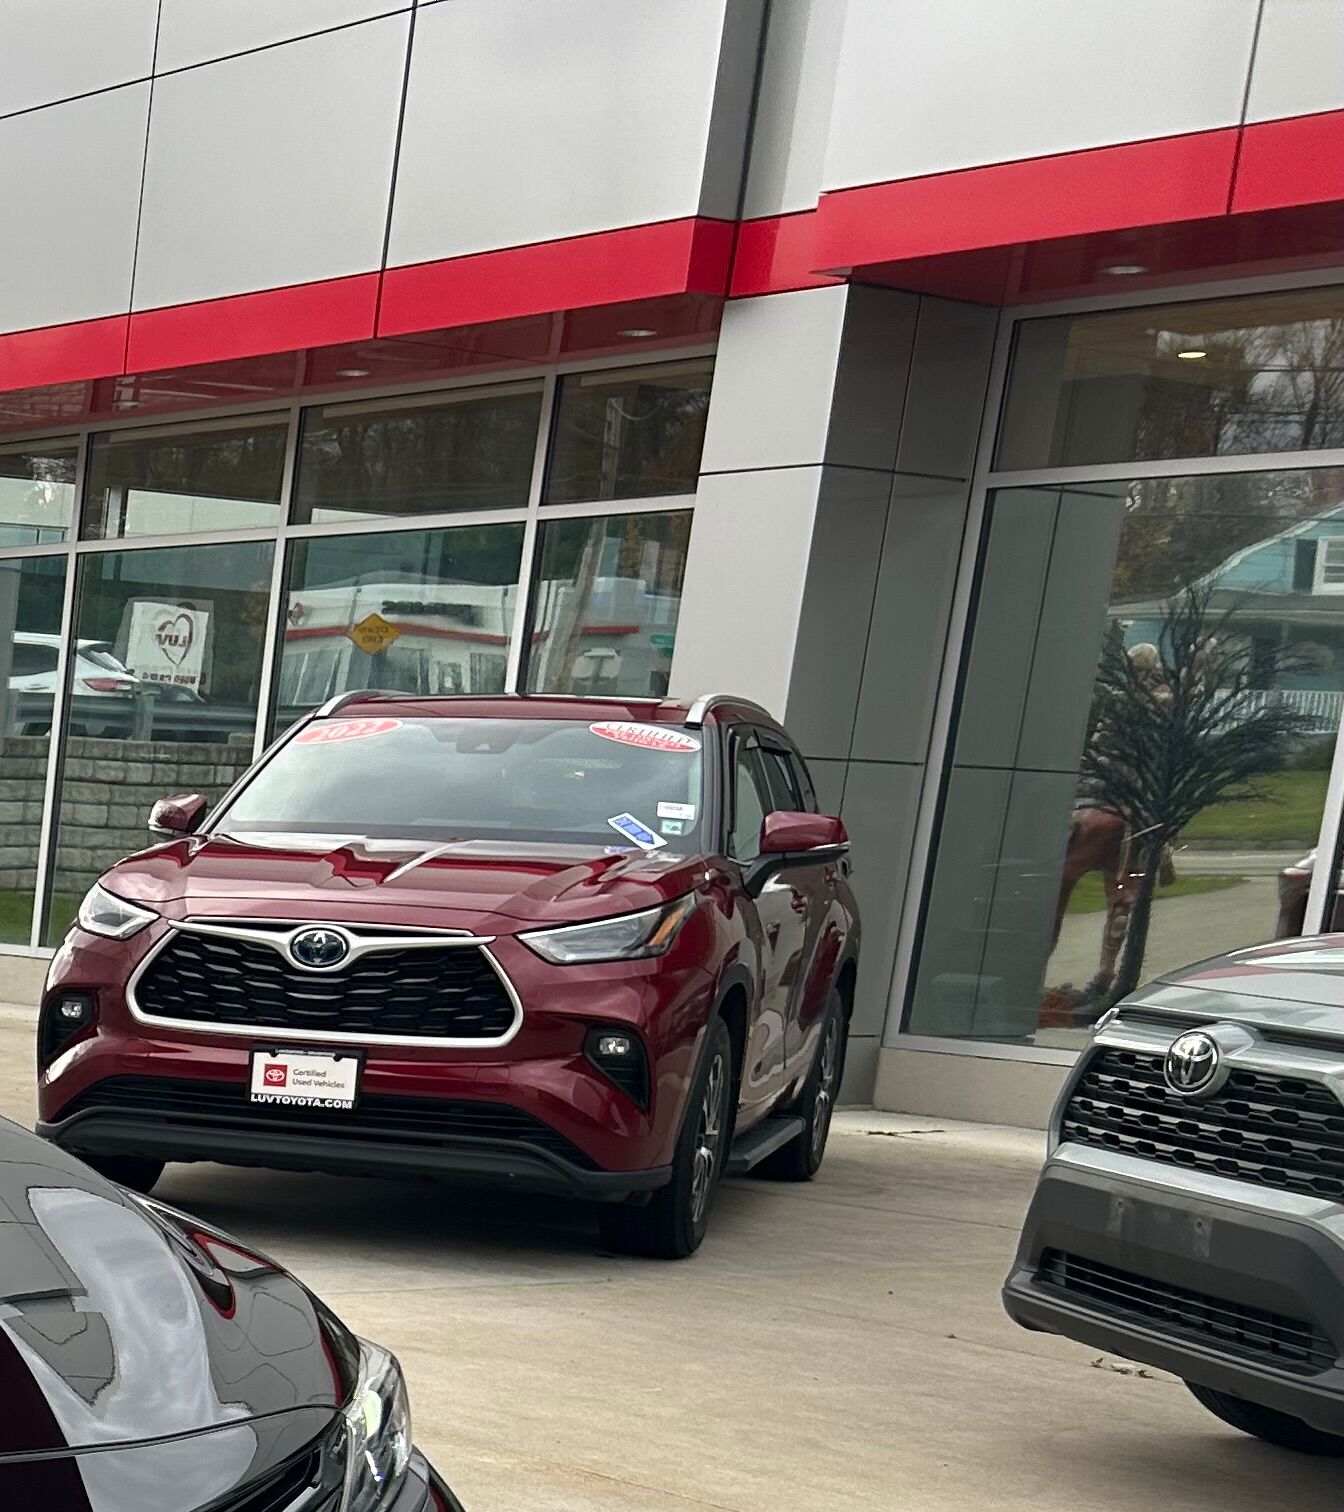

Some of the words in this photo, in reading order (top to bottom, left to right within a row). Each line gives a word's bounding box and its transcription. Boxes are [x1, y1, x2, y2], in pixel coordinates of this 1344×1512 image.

[293, 1069, 327, 1077] Certified
[314, 1080, 345, 1088] Vehicles
[250, 1093, 353, 1109] LUVTOYOTA.COM
